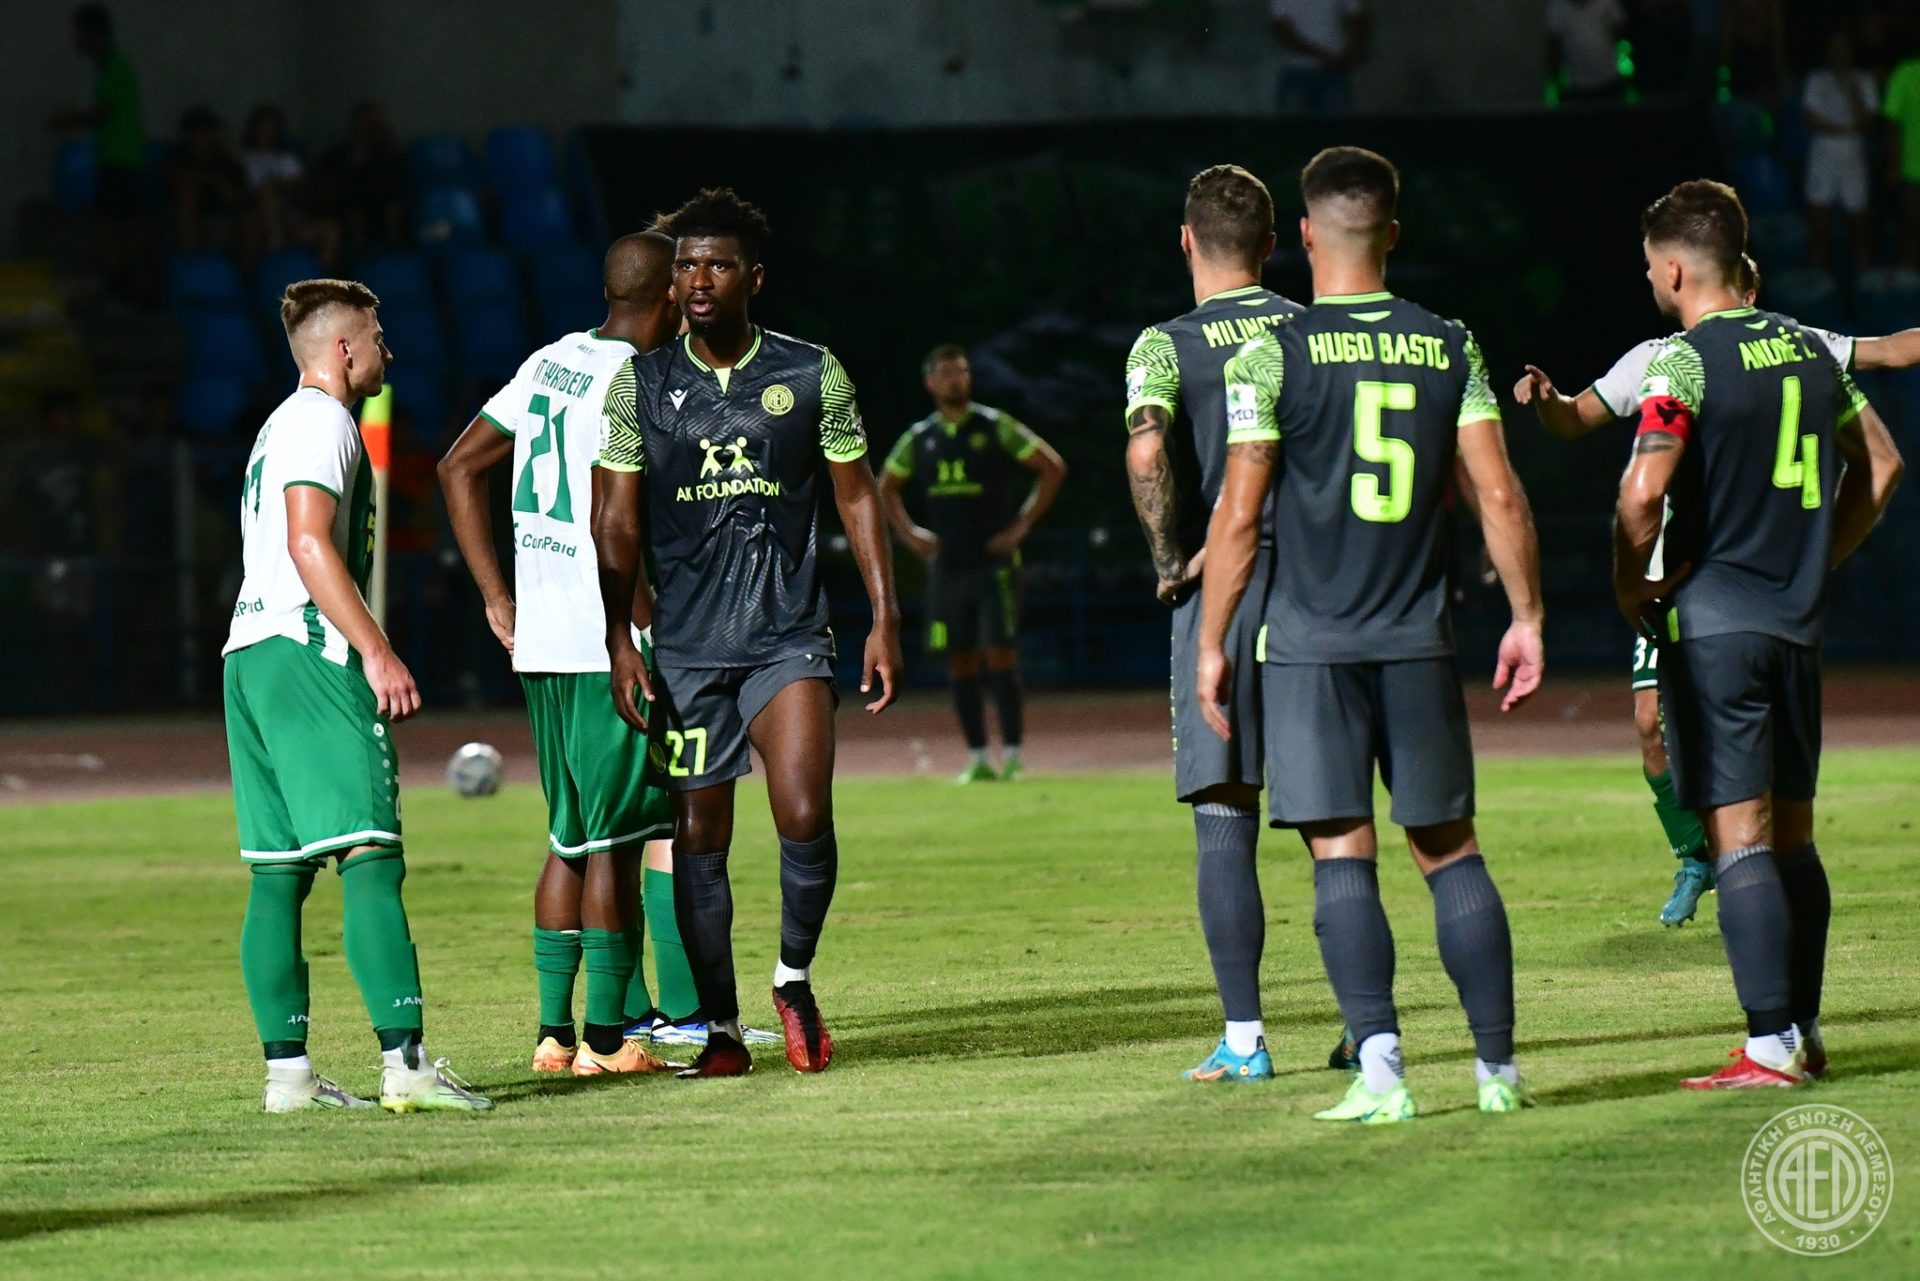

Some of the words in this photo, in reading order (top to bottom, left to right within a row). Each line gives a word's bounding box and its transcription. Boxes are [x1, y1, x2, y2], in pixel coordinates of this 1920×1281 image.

[1202, 312, 1294, 348] MILINC
[1307, 332, 1375, 365] HUGO
[512, 393, 574, 524] 21
[1351, 380, 1416, 523] 5
[1772, 375, 1821, 509] 4
[676, 486, 693, 502] AK
[696, 477, 779, 500] FOUNDATION
[665, 727, 707, 777] 27
